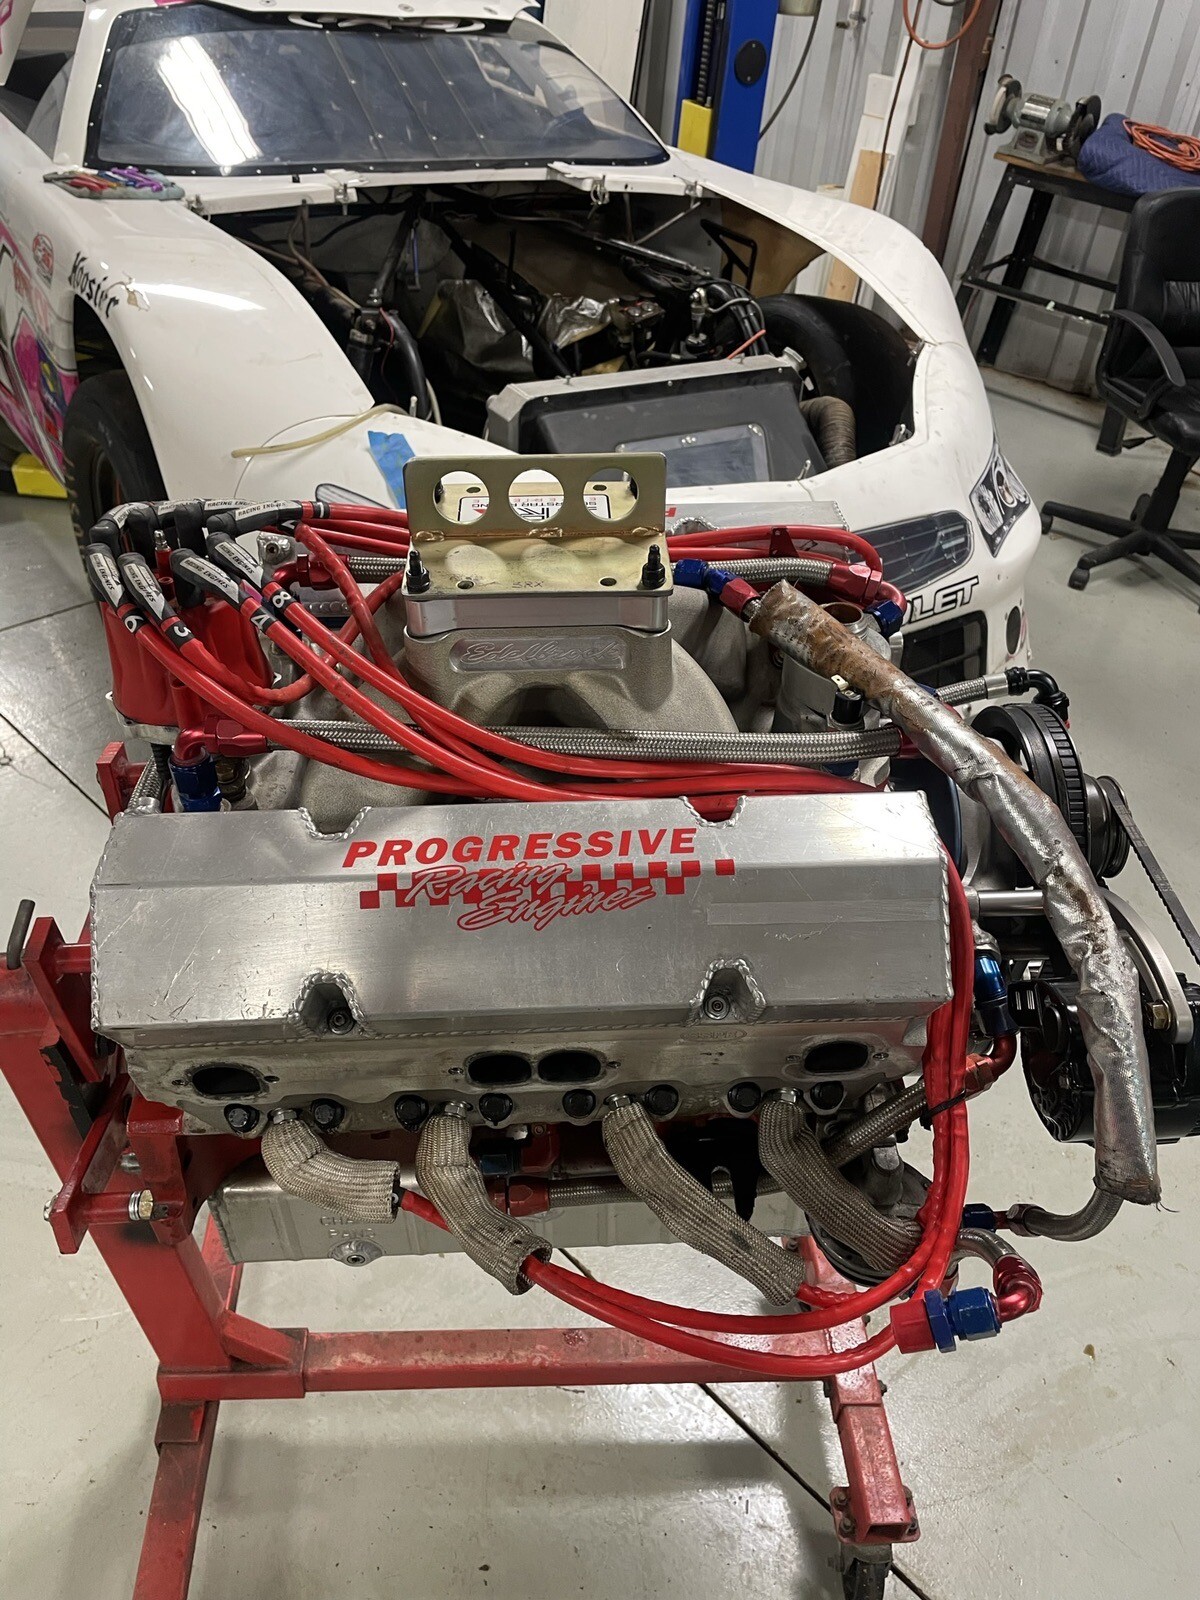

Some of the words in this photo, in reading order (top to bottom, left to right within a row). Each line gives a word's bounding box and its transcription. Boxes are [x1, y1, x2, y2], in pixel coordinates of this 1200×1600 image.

[238, 505, 261, 516] RACING
[233, 556, 255, 574] ENGINES
[99, 568, 115, 590] ENGINES
[203, 570, 229, 589] ENGINES
[135, 579, 157, 602] ENGINES
[272, 591, 292, 609] 8
[124, 615, 144, 633] 6
[459, 640, 621, 665] Edelbrock
[342, 827, 697, 868] PROGRESSIVE
[405, 861, 573, 904] Racing
[457, 884, 657, 931] Engines
